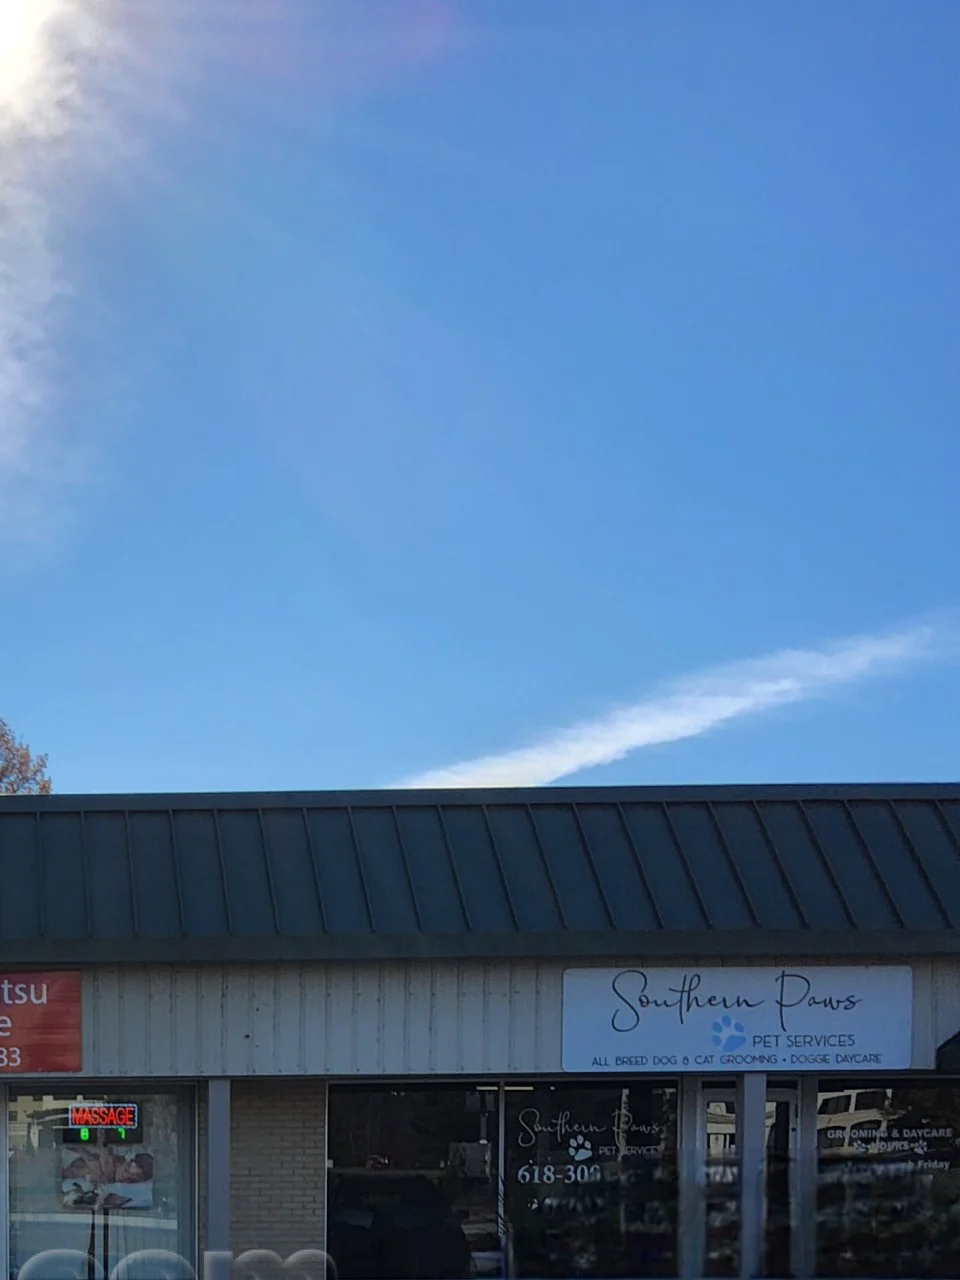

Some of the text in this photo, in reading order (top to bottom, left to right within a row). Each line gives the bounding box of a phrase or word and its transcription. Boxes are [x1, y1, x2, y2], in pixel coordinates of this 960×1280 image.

[612, 969, 863, 1033] Southern Paws
[752, 1034, 856, 1048] PET SERVICES
[591, 1057, 610, 1067] ALL
[615, 1056, 648, 1066] BREED
[653, 1056, 678, 1066] DOG
[695, 1056, 714, 1065] CAT
[720, 1055, 778, 1065] GROOMING
[836, 1053, 883, 1064] DAYCARE
[72, 1107, 135, 1125] MASSAGE
[517, 1107, 607, 1147] Southern
[827, 1128, 953, 1139] GROOMING & DAYCARE
[917, 1160, 950, 1170] Friday
